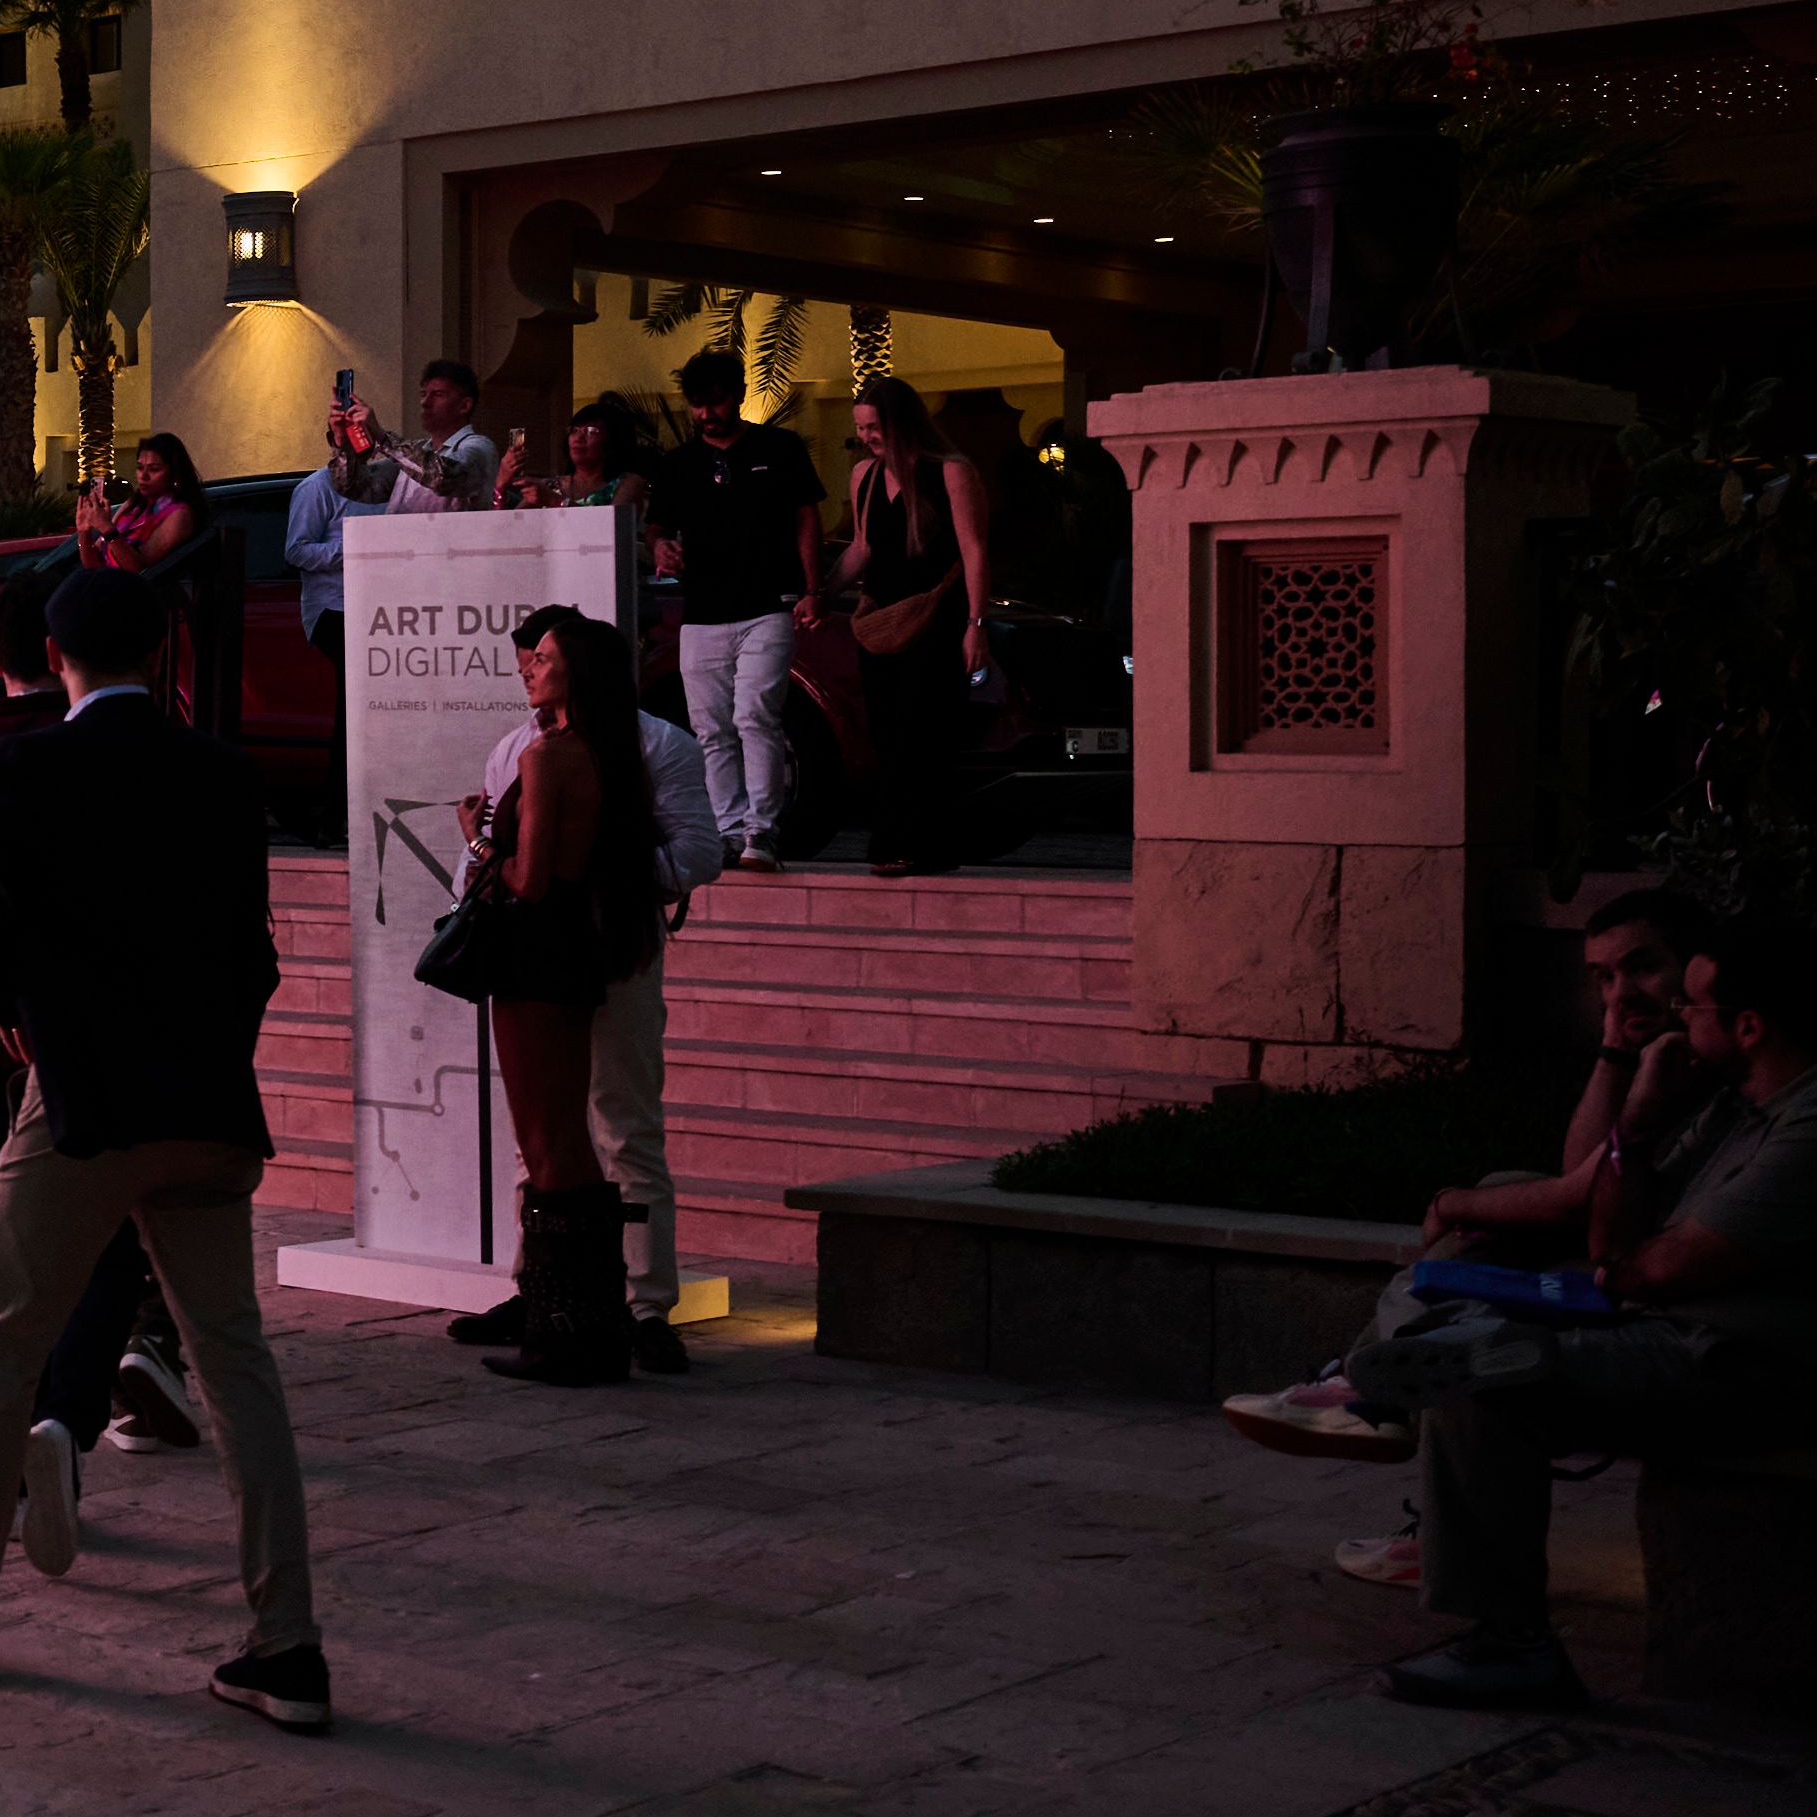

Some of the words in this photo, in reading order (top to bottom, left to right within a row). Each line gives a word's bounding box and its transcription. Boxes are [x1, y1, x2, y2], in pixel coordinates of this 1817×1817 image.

[368, 606, 443, 636] ART
[368, 646, 513, 677] DIGITAL
[368, 700, 427, 712] GALLERIES
[442, 701, 529, 713] INSTALLATIONS
